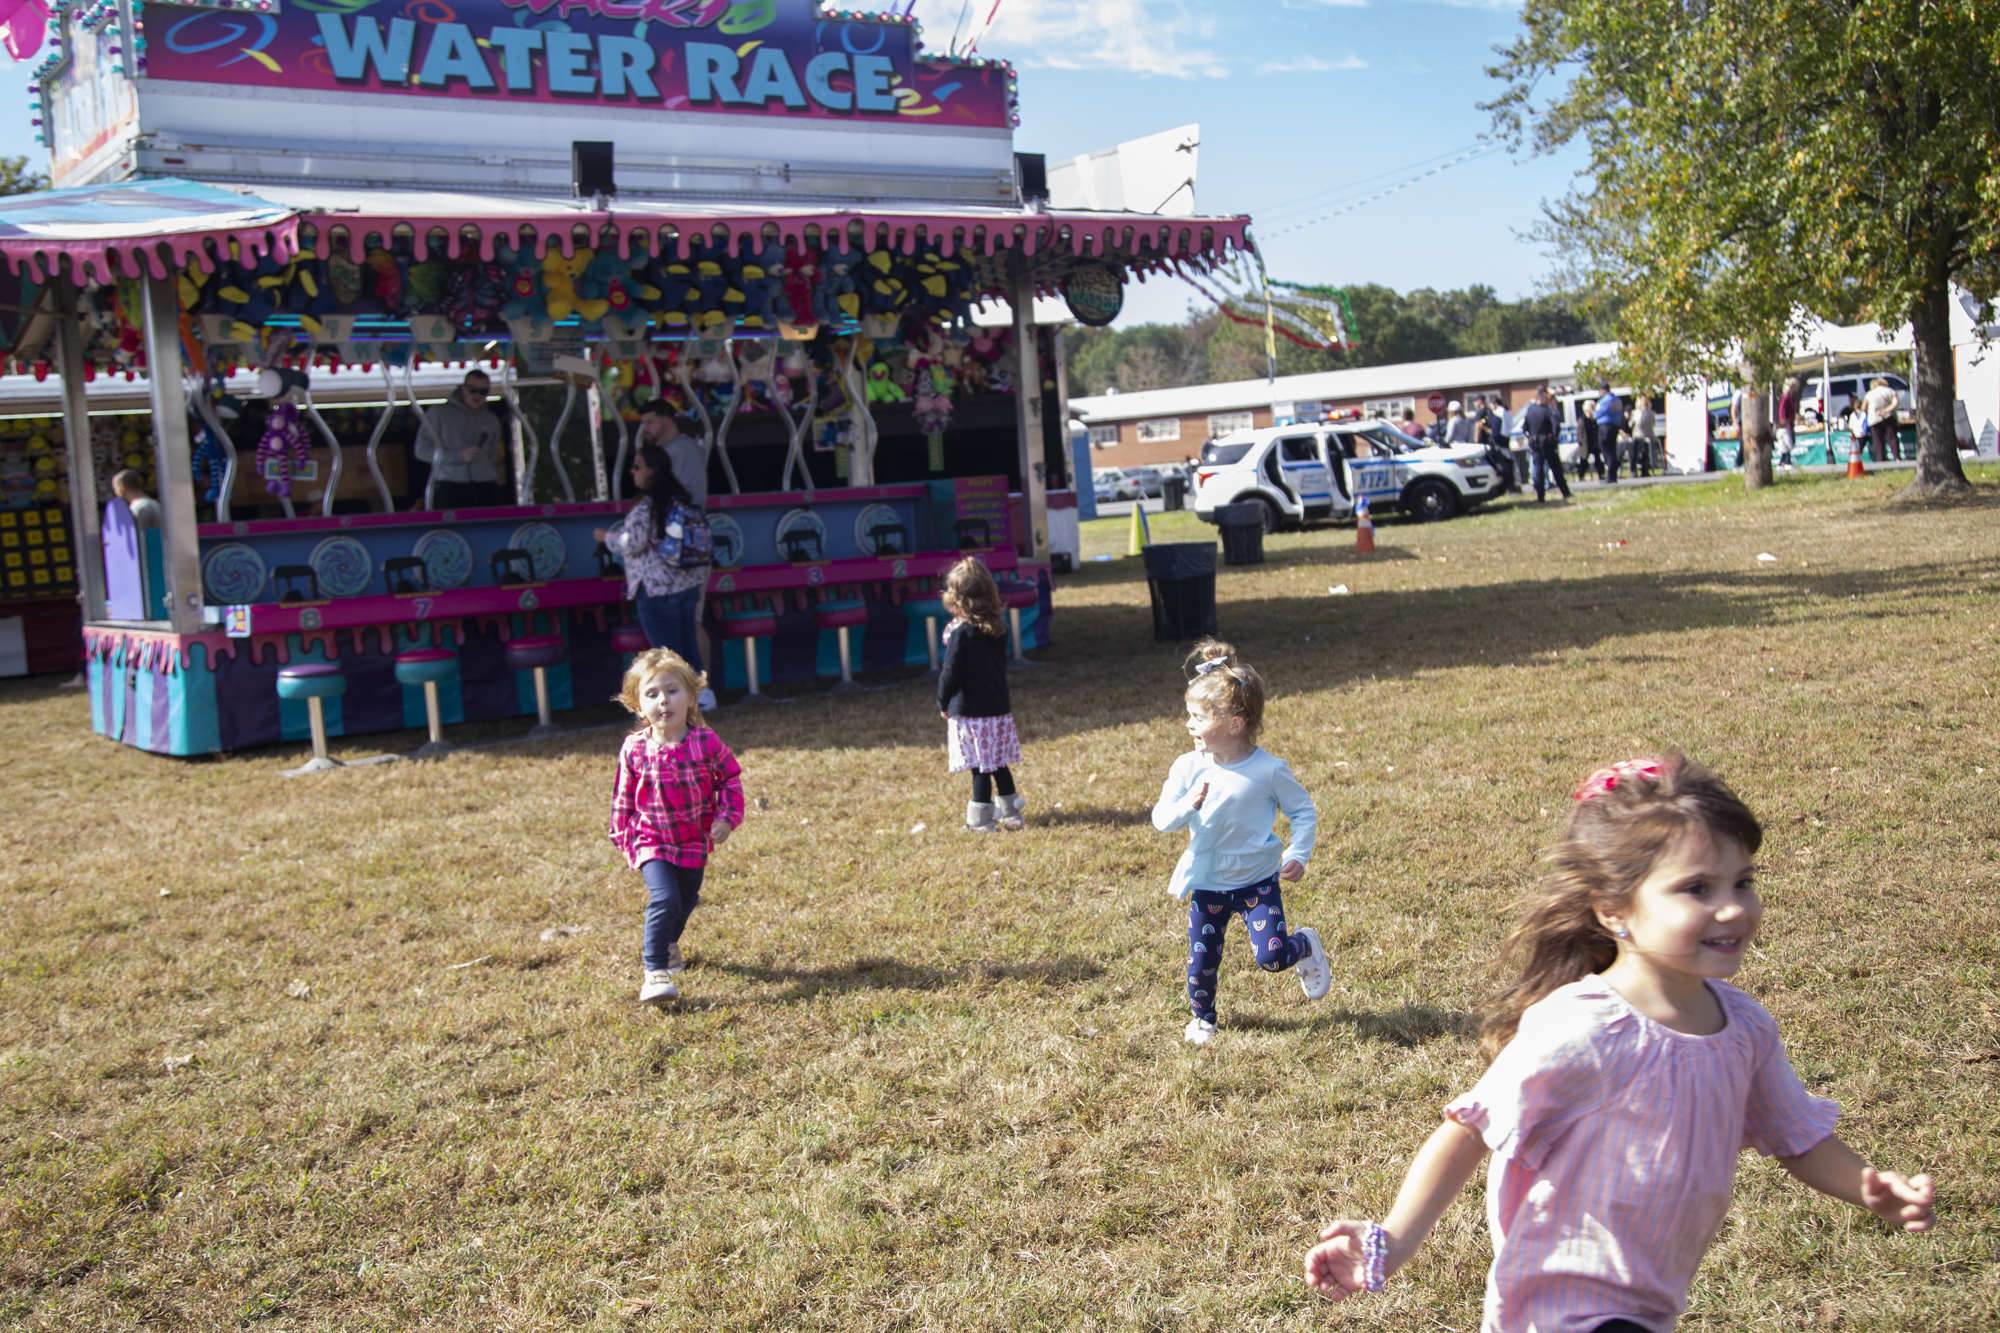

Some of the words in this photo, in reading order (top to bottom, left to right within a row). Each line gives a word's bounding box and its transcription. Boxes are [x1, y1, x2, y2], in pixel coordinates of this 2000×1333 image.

[500, 0, 728, 28] CKY
[315, 12, 662, 98] WATER
[685, 42, 899, 112] RACE
[1067, 284, 1120, 312] WATER
[326, 320, 340, 338] 7
[432, 320, 446, 338] 6
[1428, 399, 1445, 408] STOP
[808, 566, 823, 585] 3
[893, 559, 907, 578] 2
[716, 574, 735, 593] 4
[412, 597, 433, 619] 7
[518, 588, 538, 610] 6
[300, 608, 321, 630] 8
